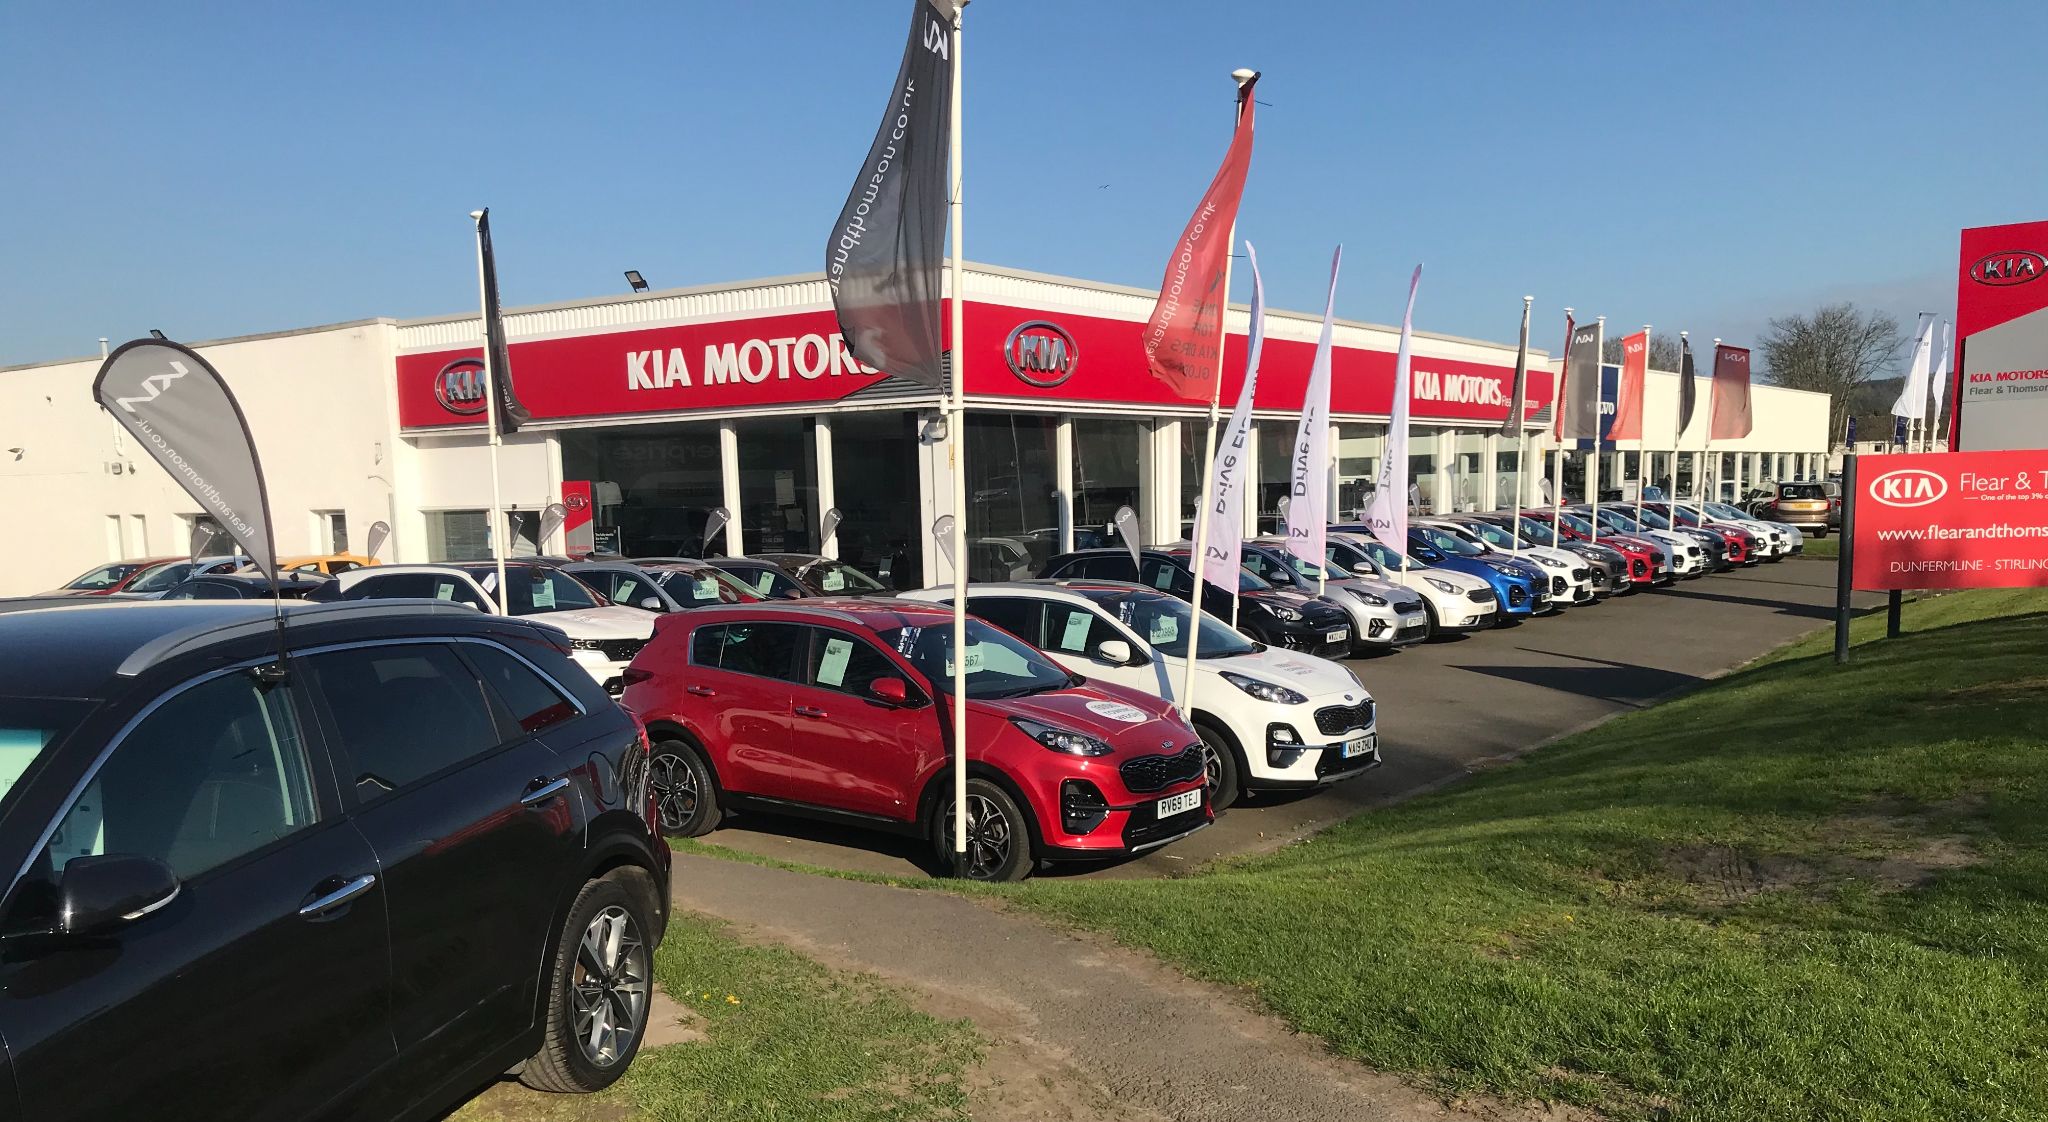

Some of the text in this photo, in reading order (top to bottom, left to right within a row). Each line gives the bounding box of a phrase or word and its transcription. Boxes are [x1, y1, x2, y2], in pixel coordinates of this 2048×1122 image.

[1983, 257, 2035, 279] KIA
[1018, 335, 1068, 374] KIA
[627, 349, 692, 391] KIA
[1970, 373, 1992, 382] KIA
[1414, 371, 1502, 406] KIA MOTORS
[1970, 387, 1993, 395] Flear
[1996, 386, 2003, 394] &
[1883, 478, 1934, 499] KIA
[1960, 473, 2009, 491] Flear
[2015, 472, 2031, 490] &
[2018, 493, 2029, 501] top
[1877, 523, 2048, 541] www.flearandthoms
[1890, 559, 1983, 573] DUNFERMLINE
[1161, 791, 1198, 815] RV69 TEJ
